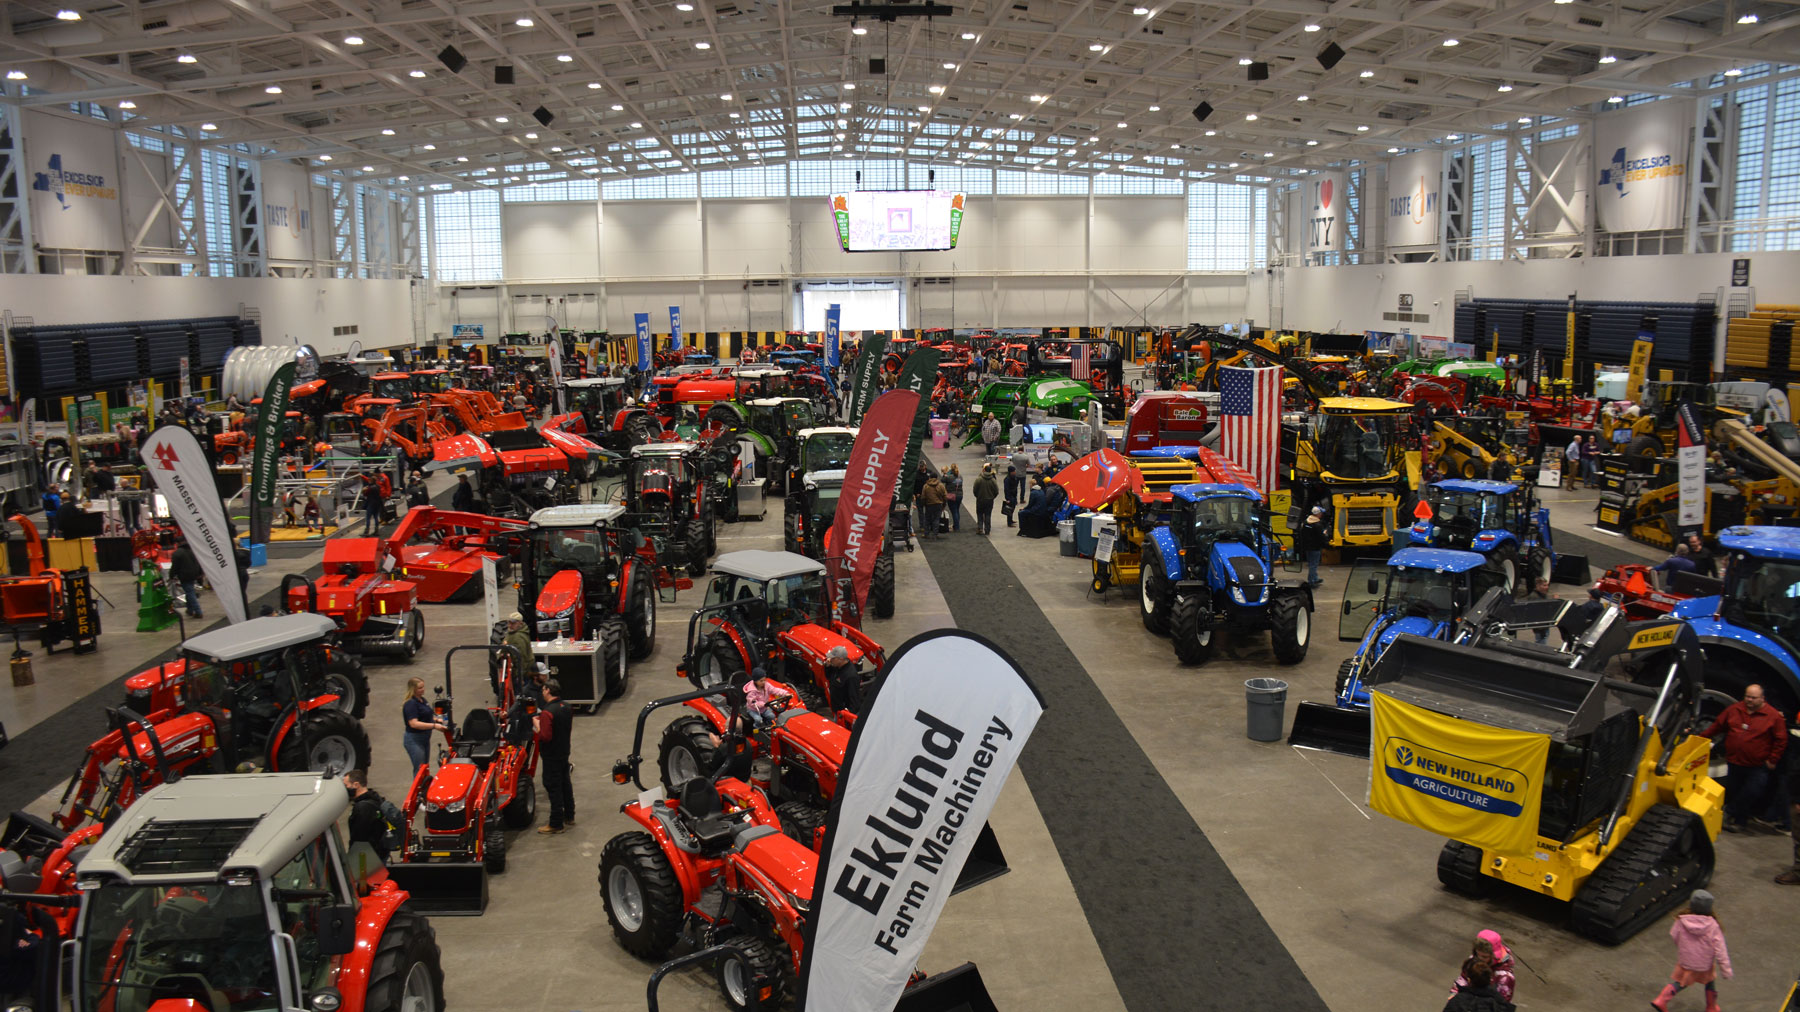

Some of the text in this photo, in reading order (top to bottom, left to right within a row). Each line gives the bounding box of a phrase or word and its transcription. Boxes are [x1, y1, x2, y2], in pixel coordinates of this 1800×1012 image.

[1625, 170, 1646, 182] EVER
[1648, 164, 1685, 179] UPWARD
[1626, 155, 1671, 171] EXCELSIOR
[64, 171, 104, 187] EXCELSIOR
[64, 182, 84, 196] EVER
[1313, 181, 1320, 211] I
[1390, 192, 1437, 217] TASTE NY
[266, 204, 288, 227] TASTE
[1310, 217, 1335, 247] NY
[828, 318, 837, 336] LS
[856, 391, 867, 417] FARM
[862, 352, 876, 388] SUPPLY
[257, 437, 277, 502] Cummings
[268, 378, 285, 423] Bricker
[841, 513, 869, 572] FARM
[857, 429, 890, 509] SUPPLY
[172, 475, 228, 569] MASSEY FERGUSON
[73, 579, 88, 635] HAMMER
[1638, 630, 1674, 644] NEW HOLLAND
[1417, 756, 1515, 794] NEW HOLLAND
[1413, 777, 1489, 808] AGRICULTURE
[833, 709, 965, 916] Eklund
[874, 715, 1014, 956] Farm Machinery
[1537, 841, 1557, 852] LAND
